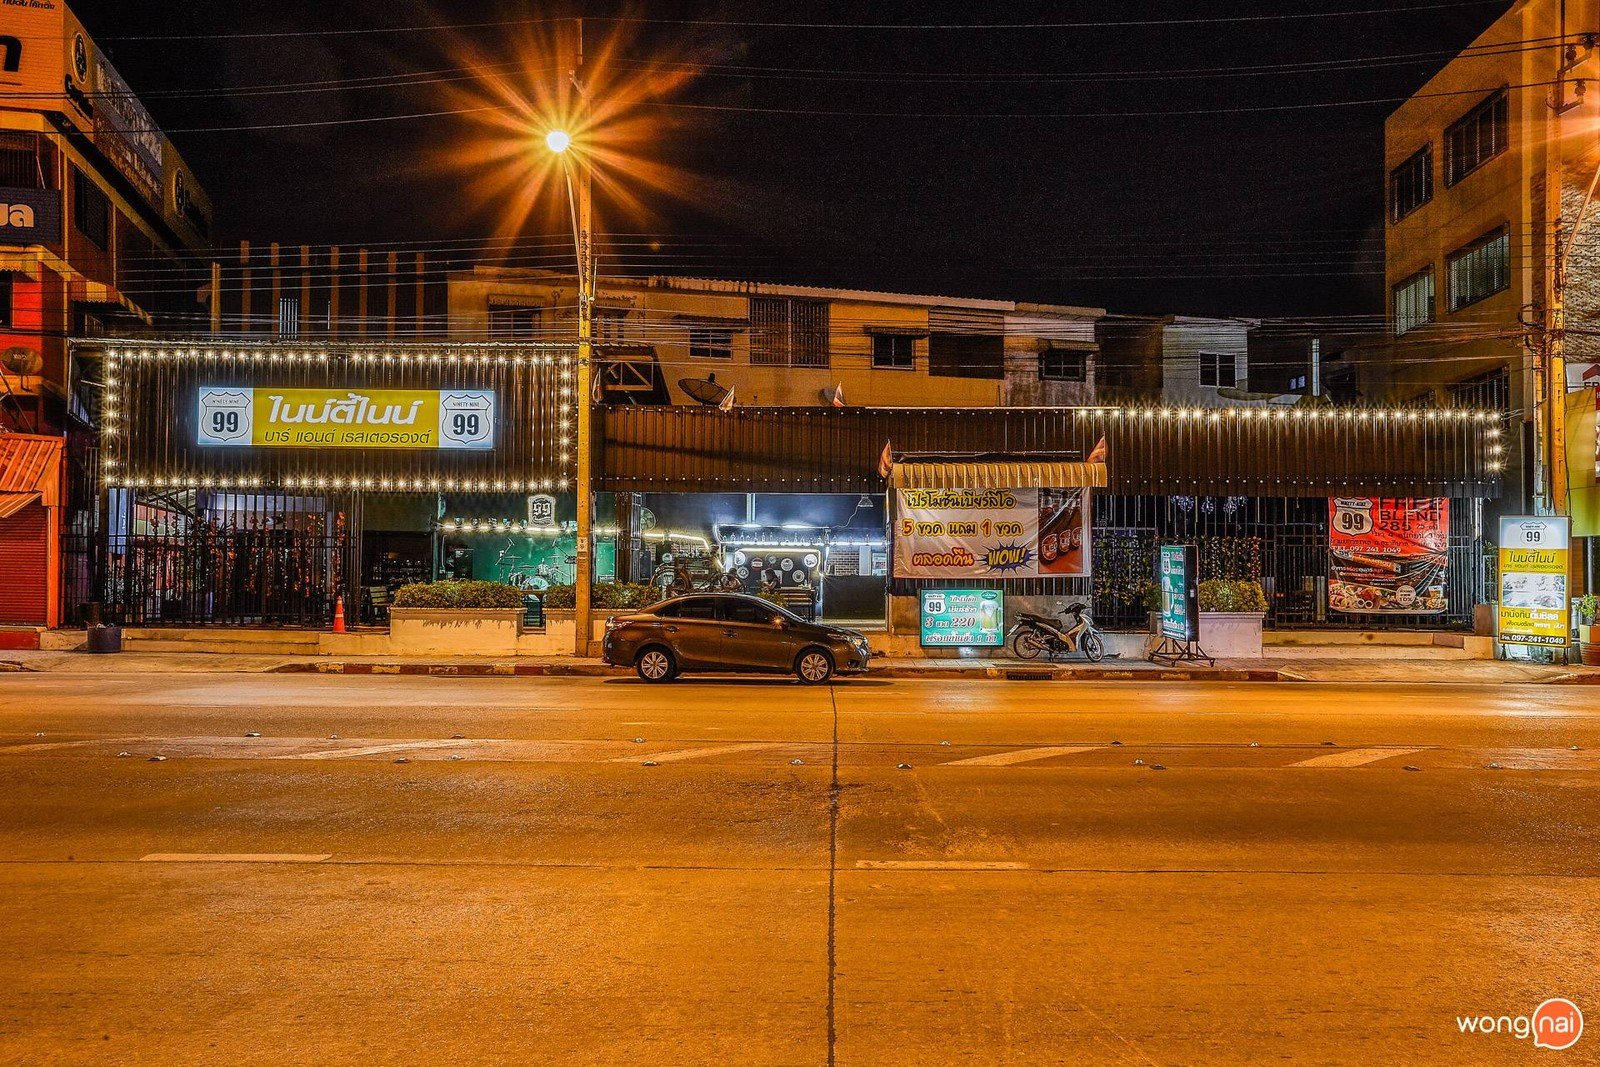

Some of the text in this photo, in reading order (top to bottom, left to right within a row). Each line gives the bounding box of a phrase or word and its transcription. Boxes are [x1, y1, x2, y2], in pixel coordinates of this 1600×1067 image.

[268, 393, 423, 424] ไนน์ตี้ไนน์
[212, 411, 239, 433] 99
[452, 413, 480, 436] 99
[264, 428, 432, 444] บาร์ แอนด์ เรสเตอรองต์
[1341, 513, 1365, 531] 99
[1380, 510, 1442, 521] BLEND
[903, 519, 1023, 537] 5 ขวด แถม 1 ขวด
[1379, 520, 1412, 532] 285
[1526, 531, 1541, 542] 99
[989, 549, 1026, 565] WOW!
[928, 601, 942, 612] 99
[951, 617, 976, 628] 220
[1511, 634, 1565, 645] 097-241-1049
